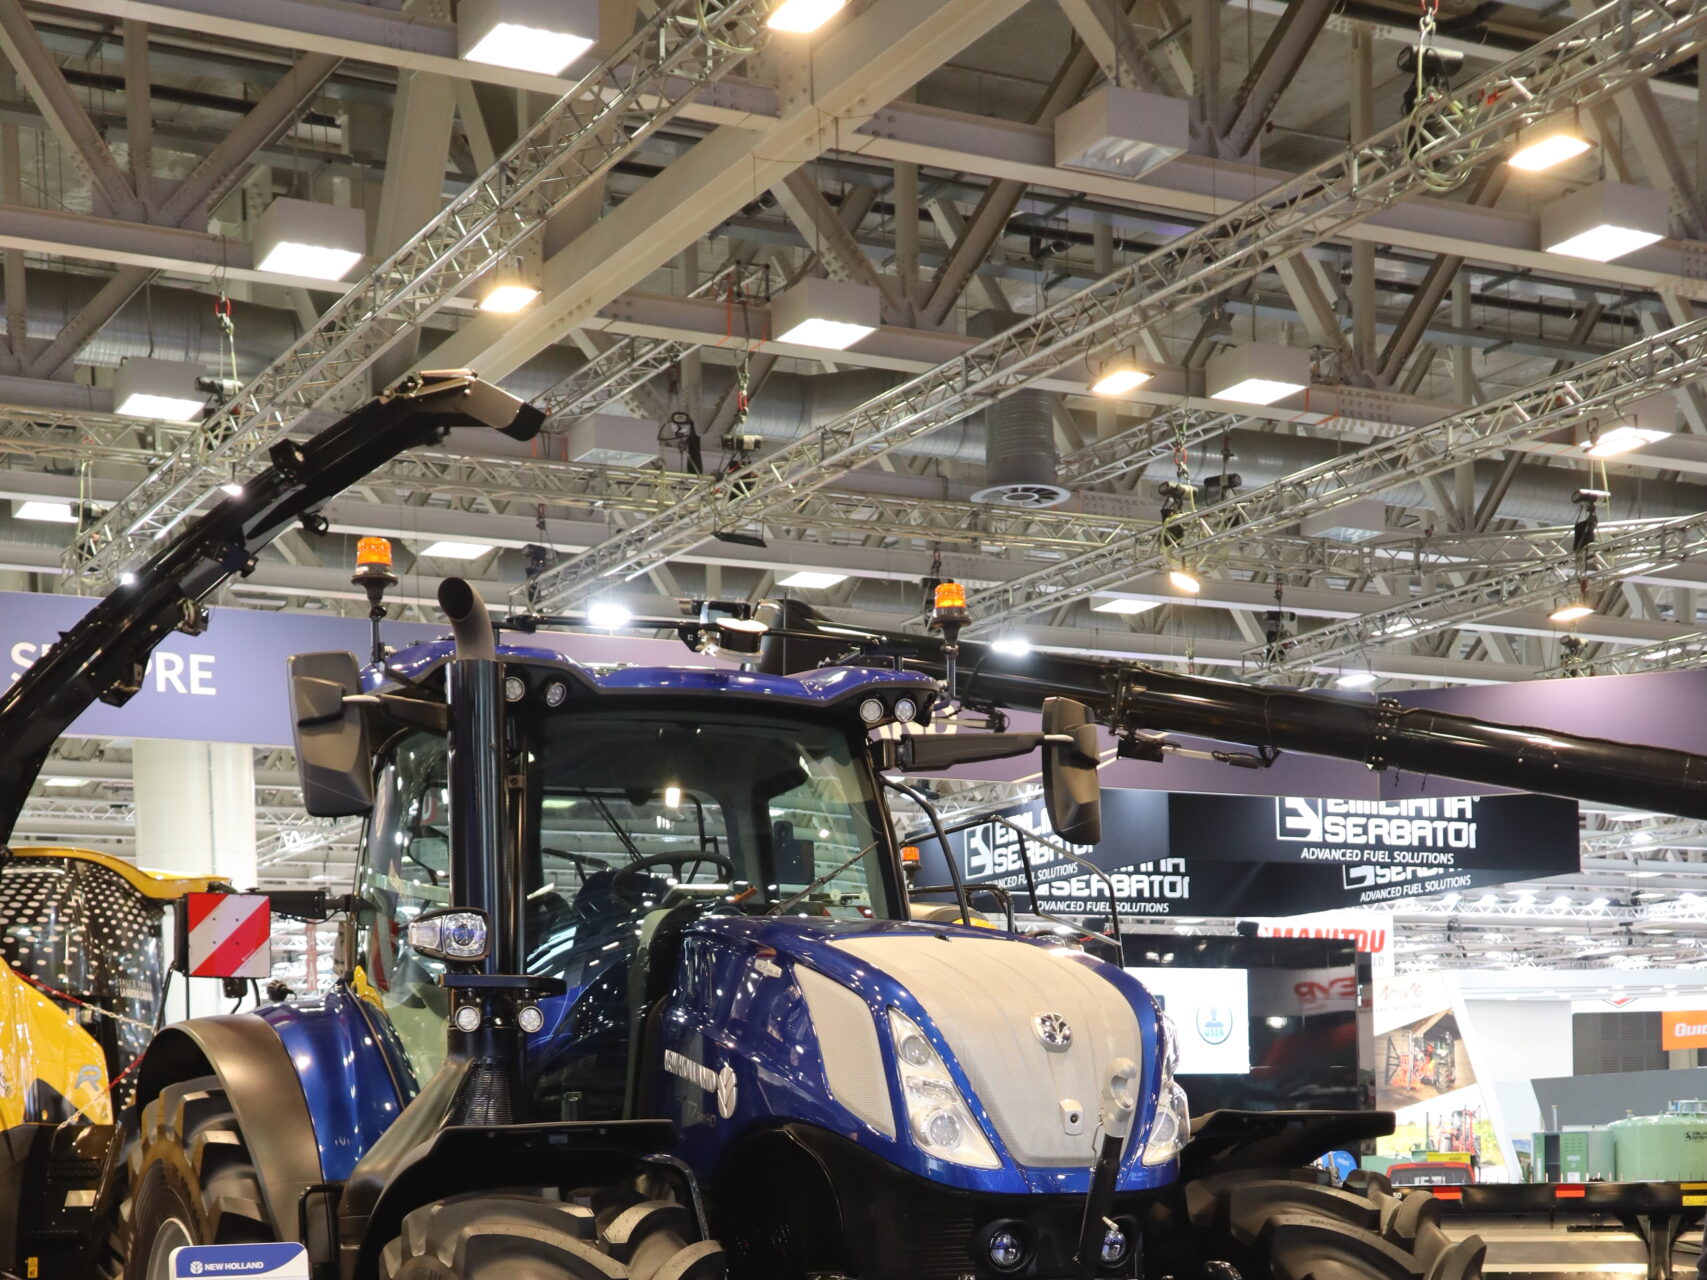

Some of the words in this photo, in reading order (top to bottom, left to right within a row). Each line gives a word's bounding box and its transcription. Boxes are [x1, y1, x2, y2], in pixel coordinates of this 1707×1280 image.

[11, 641, 216, 696] SRE
[1324, 816, 1477, 848] SERBATOI
[1301, 848, 1361, 861] ADVANCED
[1363, 850, 1391, 862] FUEL
[1393, 851, 1454, 864] SOLUTIONS
[1018, 872, 1036, 885] FUL
[1038, 862, 1078, 880] SOLUTIONS
[1360, 887, 1401, 902] ADVANCED
[1403, 883, 1423, 895] FUEL
[1425, 875, 1471, 892] SOLUTIONS
[1086, 902, 1111, 912] FUEL
[1116, 902, 1169, 913] SOLUTIONS
[204, 1263, 224, 1271] NEW
[225, 1261, 264, 1271] HOLLAND
